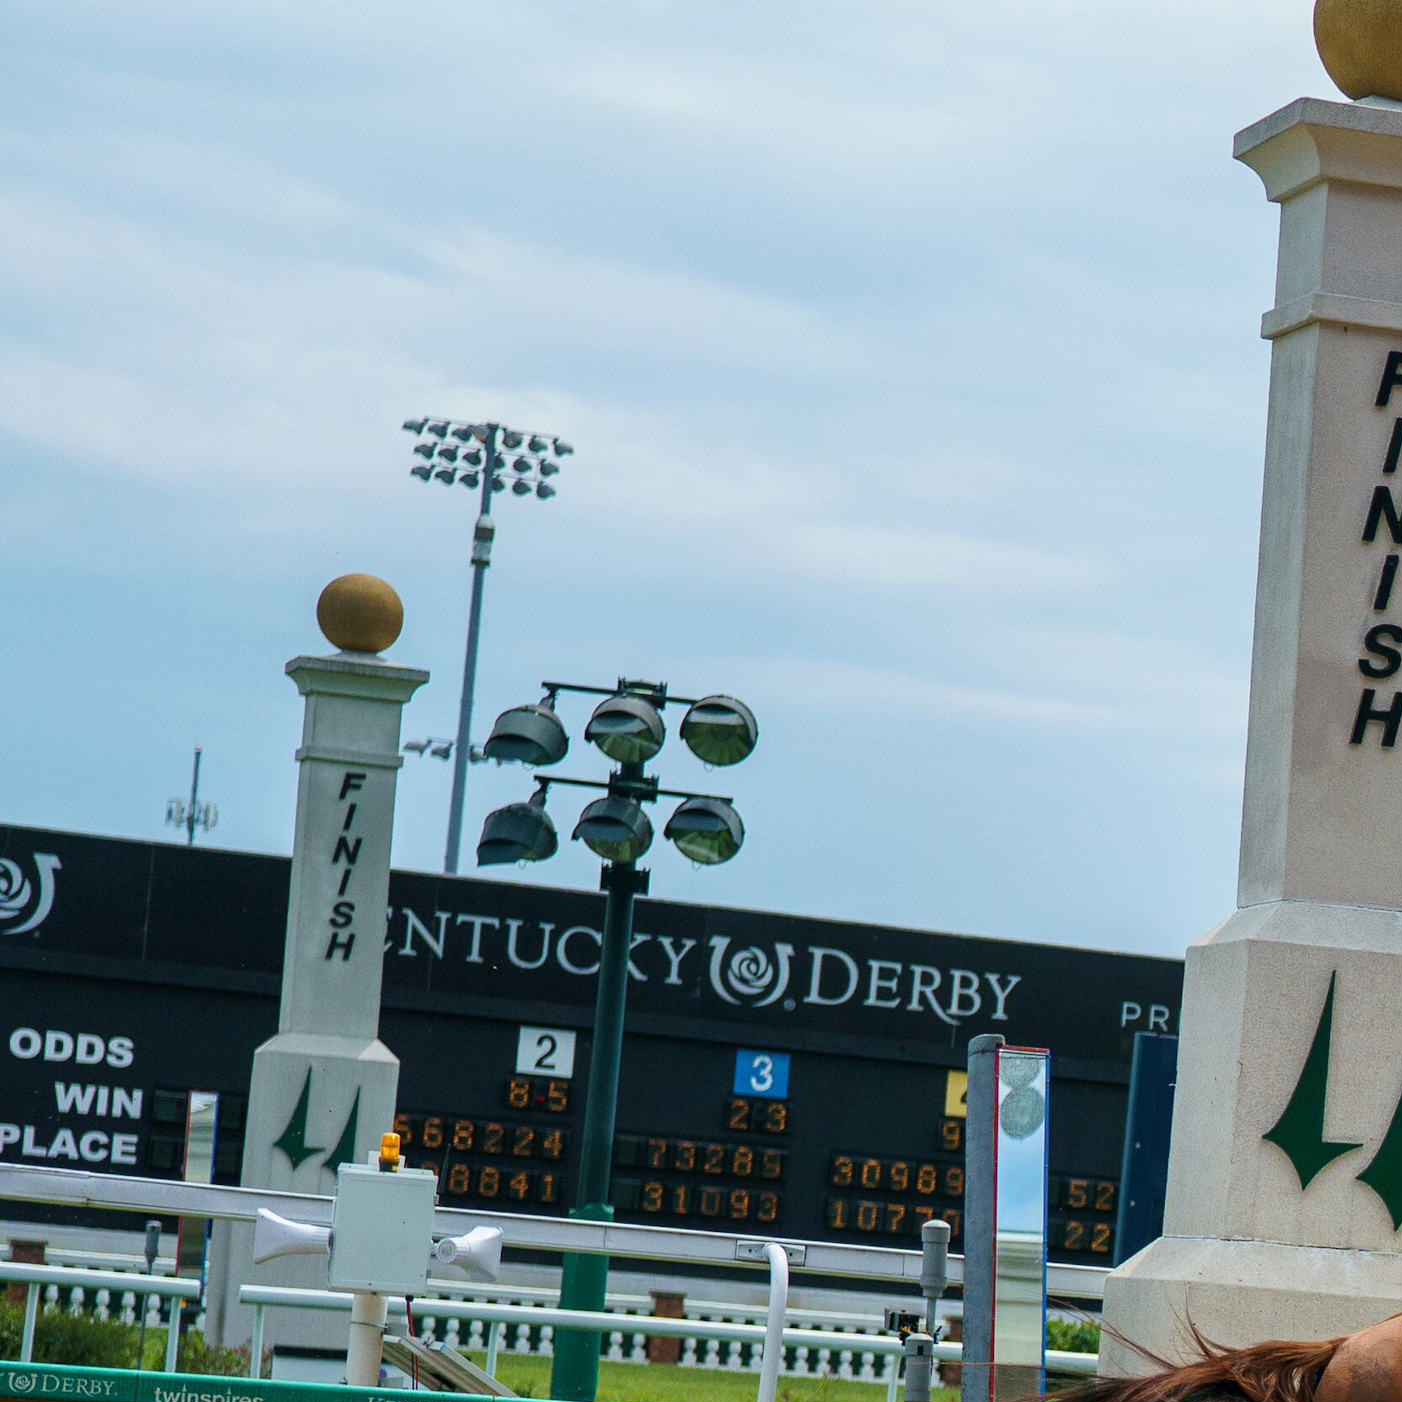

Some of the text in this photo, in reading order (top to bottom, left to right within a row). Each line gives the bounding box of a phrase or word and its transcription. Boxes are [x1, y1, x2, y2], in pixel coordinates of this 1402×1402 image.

[324, 772, 367, 962] FINISH
[384, 907, 1022, 1025] NTUCKY DERBY
[9, 1026, 135, 1069] ODDS
[534, 1034, 557, 1070] 2
[750, 1054, 774, 1092] 3
[54, 1081, 143, 1119] WIN
[0, 1123, 139, 1165] PLACE
[40, 1373, 115, 1398] DERBY
